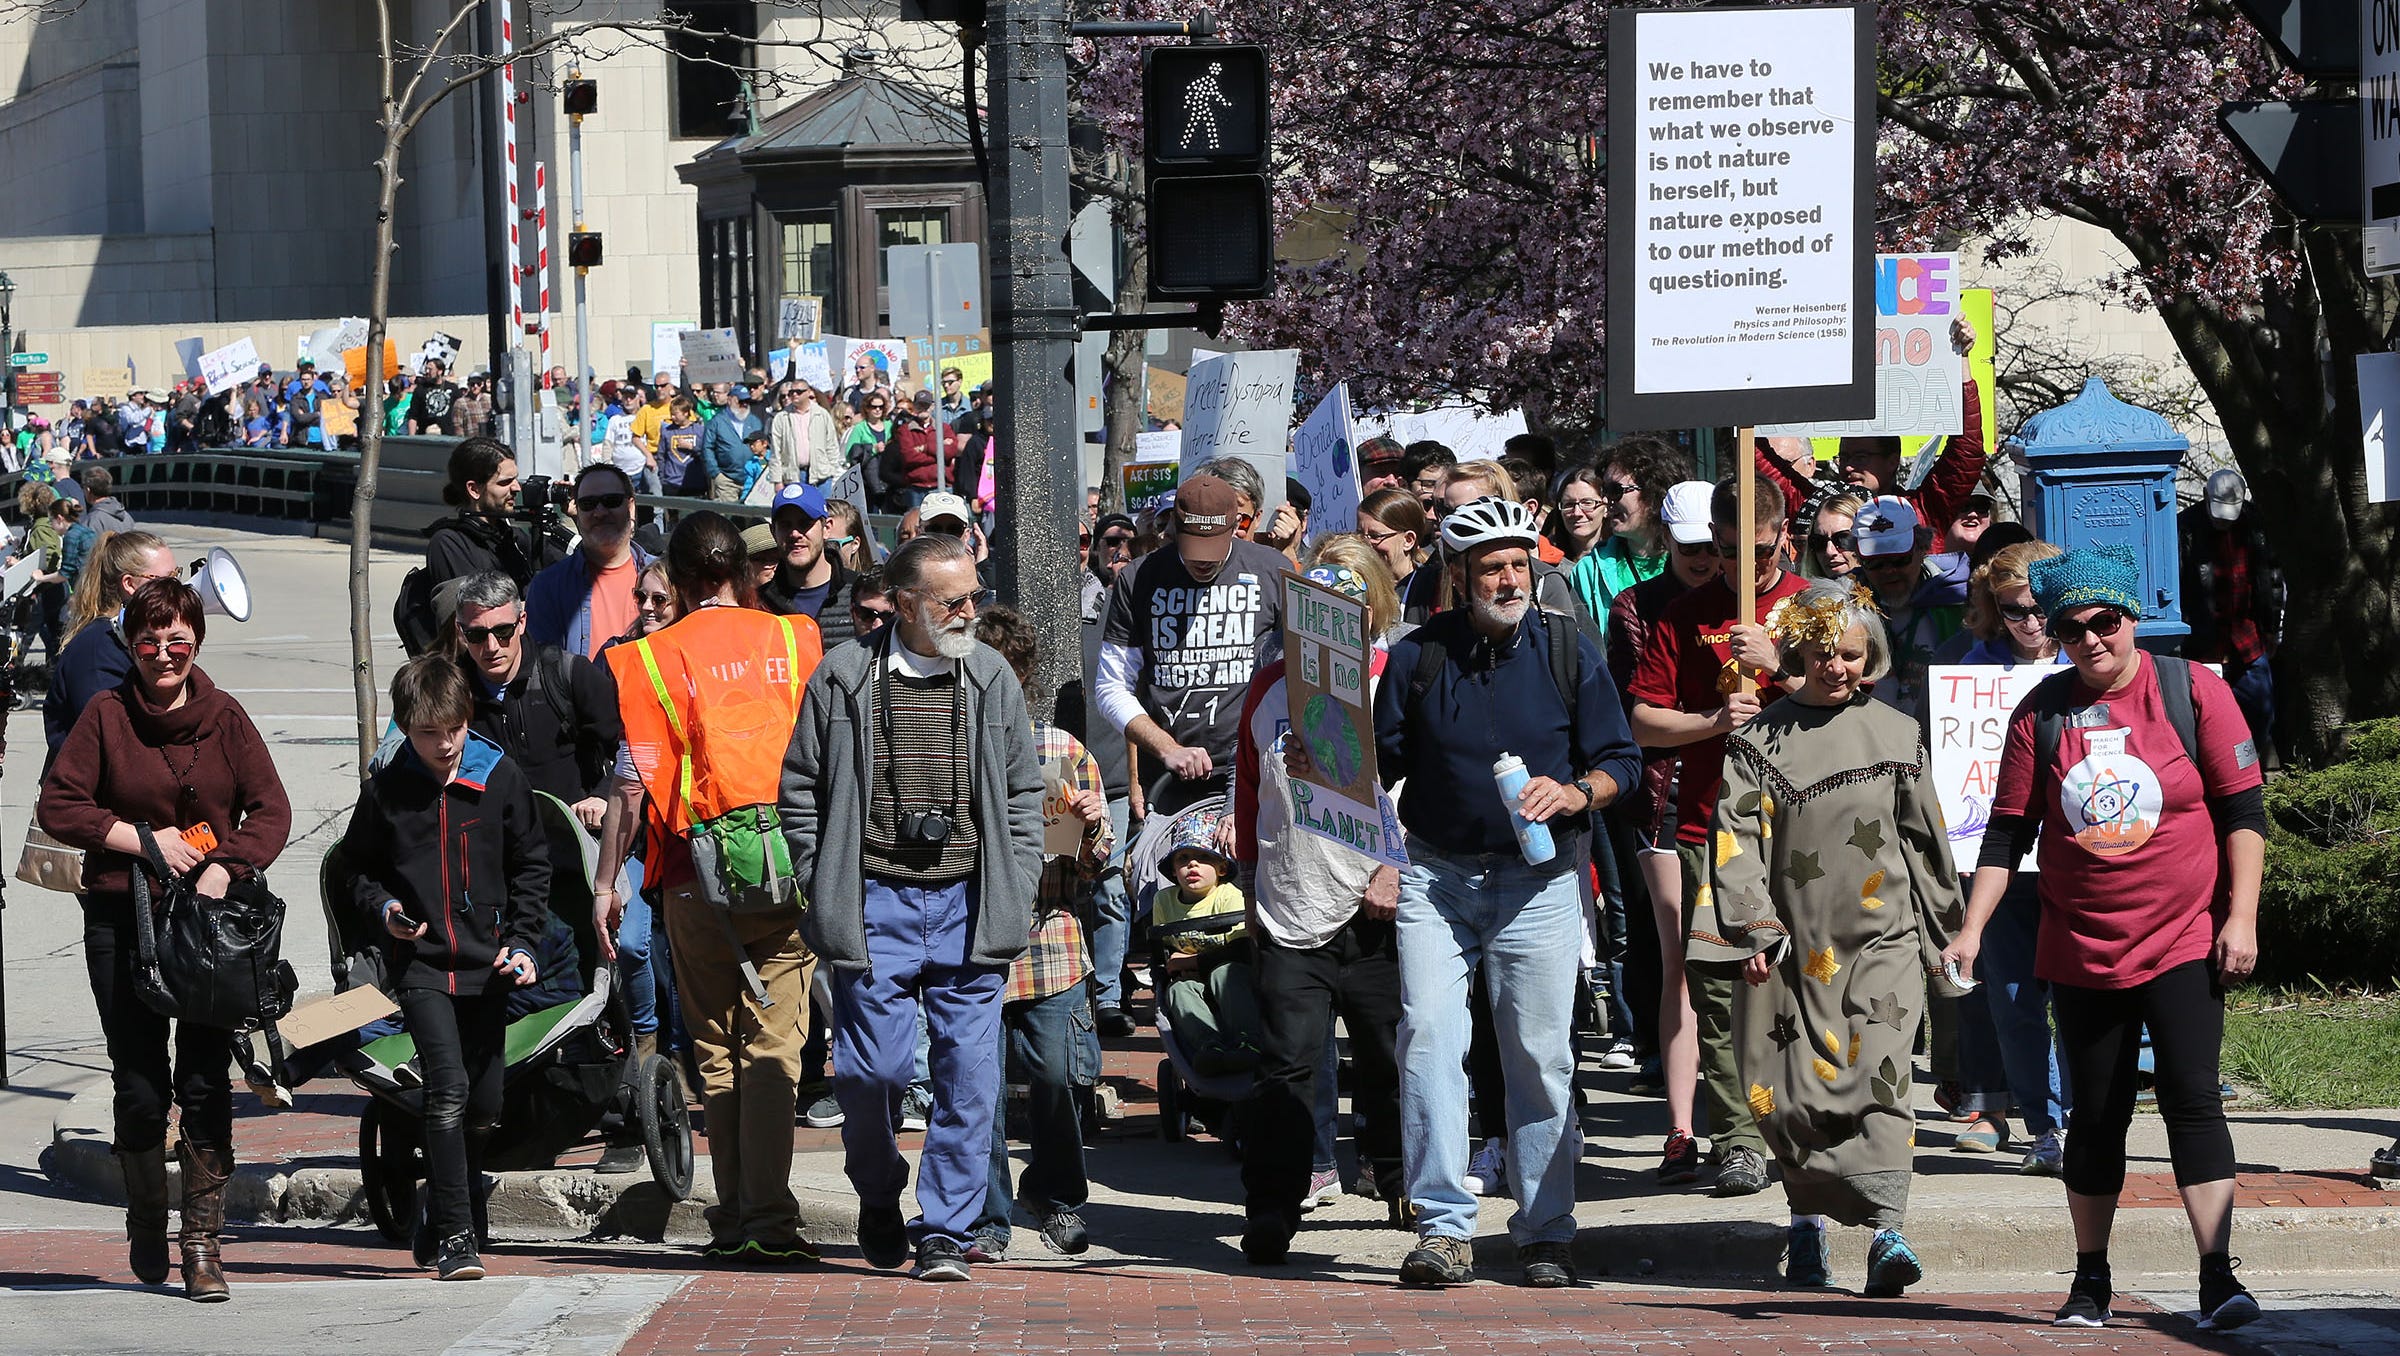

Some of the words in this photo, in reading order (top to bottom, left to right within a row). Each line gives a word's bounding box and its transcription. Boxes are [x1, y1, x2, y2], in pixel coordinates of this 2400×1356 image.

[2373, 0, 2400, 56] ON
[1649, 62, 1683, 81] We
[1691, 60, 1743, 80] have
[1749, 58, 1772, 78] to
[1649, 88, 1763, 111] remember
[1769, 86, 1813, 106] that
[2371, 71, 2400, 141] WA
[1649, 120, 1703, 141] what
[1711, 121, 1741, 138] we
[1748, 115, 1834, 137] observe
[1649, 151, 1668, 171] is
[1675, 150, 1712, 169] not
[1719, 148, 1790, 168] nature
[1649, 179, 1736, 201] herself,
[1742, 177, 1778, 197] but
[1649, 210, 1722, 231] nature
[1730, 205, 1822, 231] exposed
[1649, 242, 1671, 261] to
[1678, 241, 1715, 259] our
[1722, 236, 1804, 258] method
[1811, 233, 1833, 253] of
[1649, 267, 1788, 294] questioning.
[1756, 306, 1790, 314] Werner
[1793, 302, 1847, 313] Heisenberg
[1734, 320, 1770, 331] Physics
[1772, 318, 1790, 327] and
[1793, 316, 1847, 327] Philosophy:
[912, 337, 958, 356] Thre
[1651, 337, 1669, 346] The
[1672, 334, 1724, 345] Revolution
[1727, 334, 1736, 342] in
[1739, 332, 1775, 342] Modern
[1778, 330, 1815, 340] Science
[1817, 328, 1847, 339] (1958)
[1876, 328, 1932, 366] no
[1150, 584, 1261, 616] SCIENCE
[1288, 581, 1363, 651] THERE
[1152, 616, 1178, 650] IS
[1186, 612, 1256, 648] REAL
[1181, 645, 1255, 664] ALTERNATIVE
[1940, 675, 2014, 710] THE
[1289, 778, 1380, 853] PLANET
